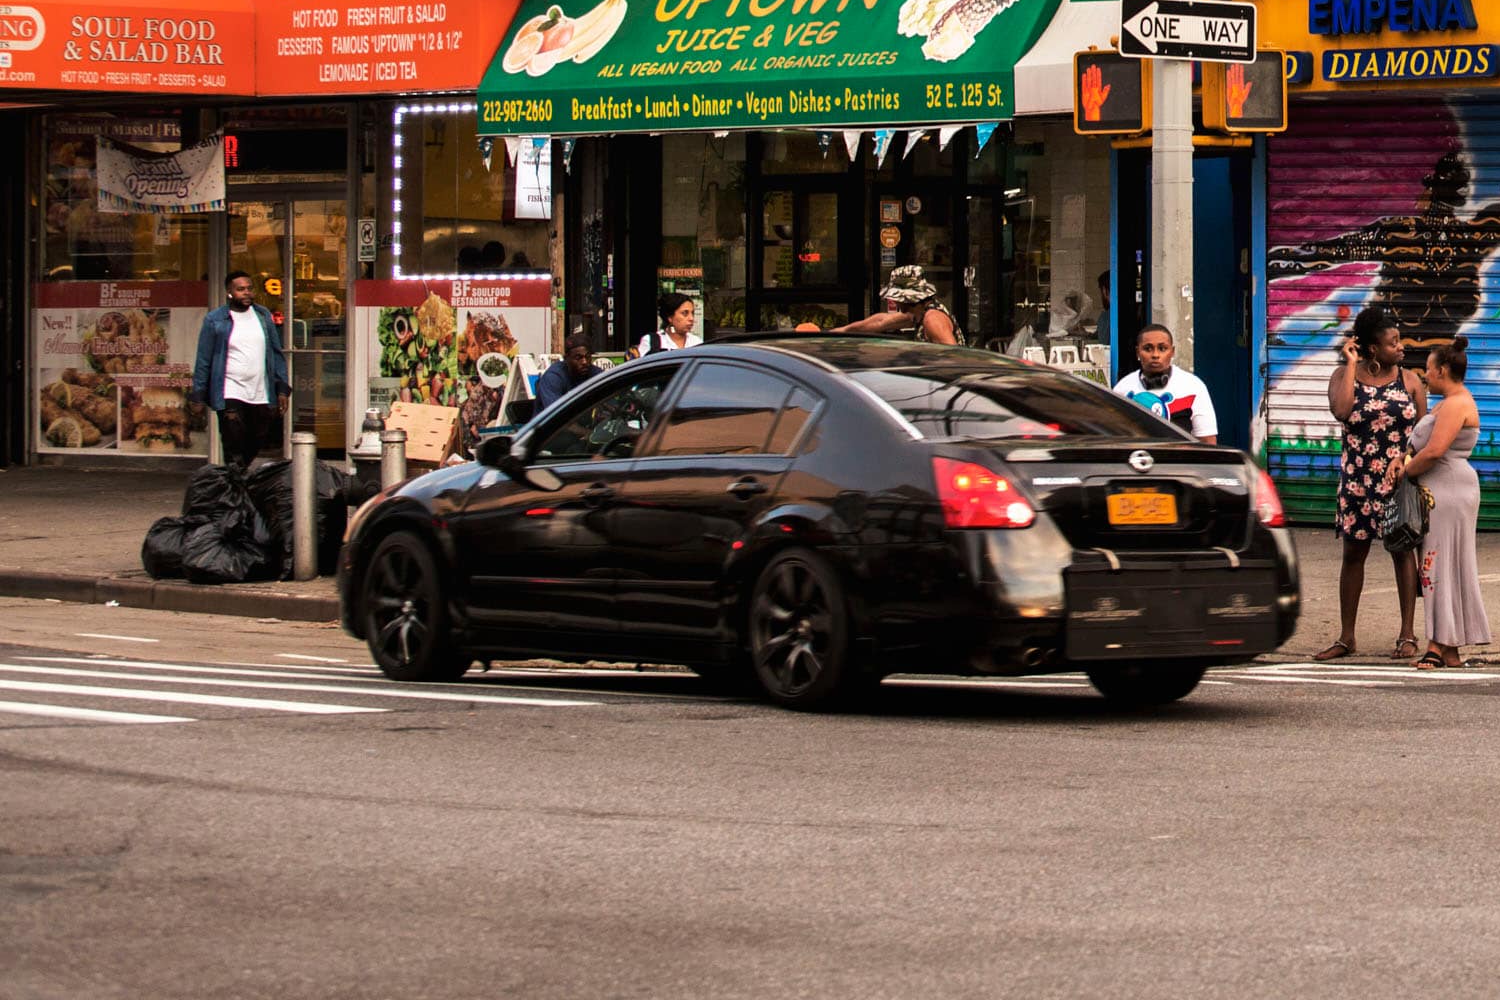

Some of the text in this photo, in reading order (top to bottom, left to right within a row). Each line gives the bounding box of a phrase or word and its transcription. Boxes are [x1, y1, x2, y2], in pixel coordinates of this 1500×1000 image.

[292, 3, 446, 28] HOT FOOD FRESH FRUIT & SALAD
[71, 16, 215, 41] SOUL FOOD
[656, 20, 840, 54] JUICE & VEG
[1140, 16, 1243, 44] ONE WAY
[64, 40, 224, 65] & SALAD BAR
[597, 51, 899, 78] ALL VEGAN FOOD ALL ORGANIC JUICES
[1329, 48, 1491, 81] DIAMONDS
[61, 71, 226, 87] HOT FOOD FRESH FRUIT DESSERTS SALAD
[483, 83, 1004, 122] 212-987-2660 Breakfast Lunch Dinner Vegan Dishes Pastries 52 E. 125 St.
[131, 157, 183, 175] Grand
[124, 174, 189, 198] Opening
[100, 283, 118, 298] BF
[451, 279, 511, 297] BF SOULFOOD
